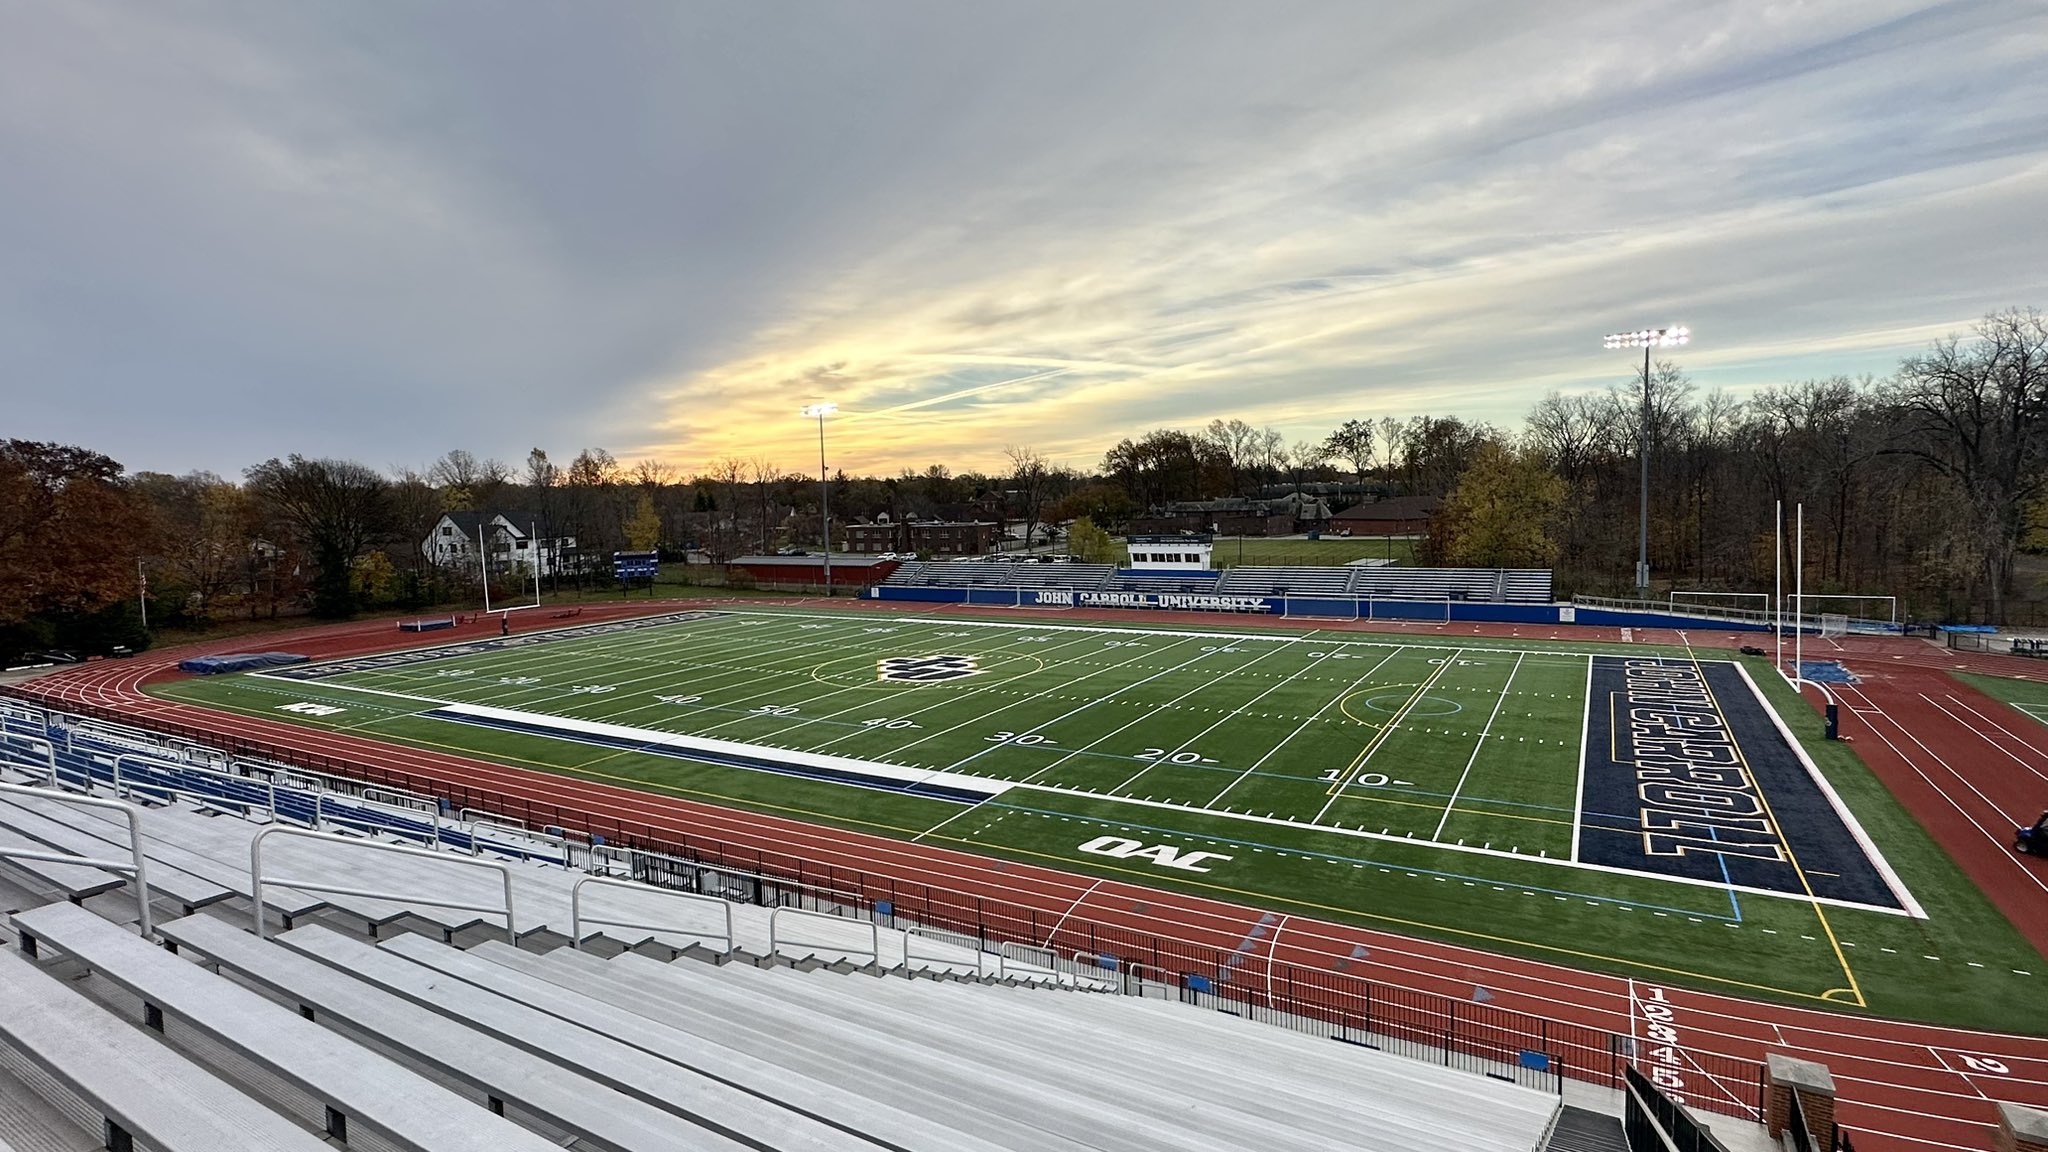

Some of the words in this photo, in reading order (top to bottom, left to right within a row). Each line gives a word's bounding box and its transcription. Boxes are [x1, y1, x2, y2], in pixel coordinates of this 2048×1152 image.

[1035, 592, 1073, 604] JOHN
[1080, 593, 1148, 606] CARROLL
[1158, 595, 1264, 610] UNIVERSITY
[1625, 660, 1713, 709] JOHN
[749, 705, 800, 716] 50
[861, 717, 914, 729] 40
[983, 731, 1045, 745] 30
[1133, 748, 1201, 764] 20
[1316, 768, 1390, 786] 10
[1630, 708, 1788, 862] CARROLL
[1077, 835, 1234, 873] OAC
